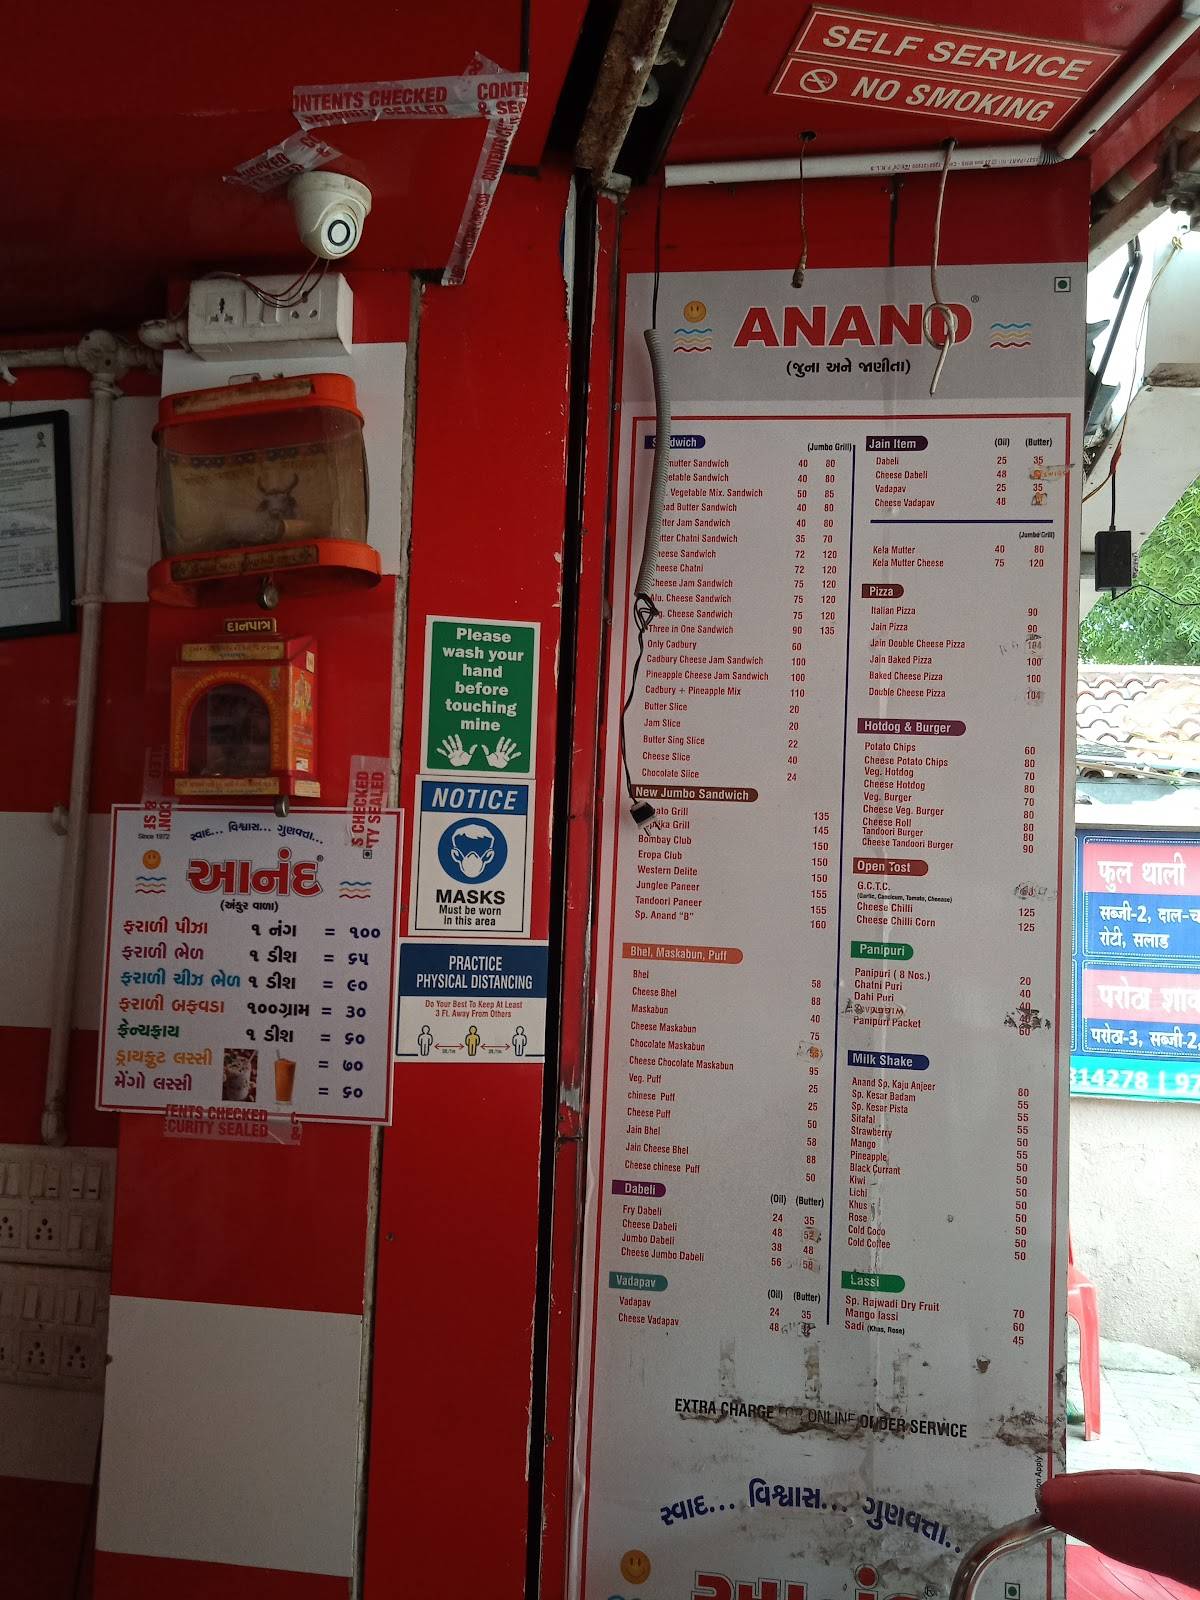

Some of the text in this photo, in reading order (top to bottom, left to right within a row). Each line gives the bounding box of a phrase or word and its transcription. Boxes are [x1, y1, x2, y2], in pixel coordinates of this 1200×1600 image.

[823, 25, 1092, 82] SELF SERVICE
[369, 87, 447, 106] CHECKED
[850, 76, 1055, 121] NO SMOKING
[733, 303, 973, 348] ANAND
[787, 358, 910, 377] (જુના અને જાણીતા)
[808, 443, 852, 452] (Jumbo Grill)
[869, 439, 916, 449] Jain Item
[671, 489, 763, 498] Vegetable Mix. Sandwich
[797, 490, 807, 498] 50
[825, 490, 834, 498] 85
[891, 546, 915, 554] Mutter
[995, 545, 1005, 553] 40
[1034, 545, 1044, 553] 80
[870, 587, 894, 596] Pizza
[871, 607, 915, 615] Italian Pizza
[1028, 608, 1038, 616] 90
[457, 628, 512, 643] Please
[649, 625, 668, 633] Three
[697, 626, 733, 634] Sandwich
[792, 627, 802, 635] 90
[821, 627, 834, 635] 135
[443, 647, 524, 663] wash your
[463, 664, 503, 678] hand
[455, 682, 509, 696] before
[445, 699, 518, 717] touching
[461, 719, 501, 732] mine
[864, 721, 951, 733] Hotdog & Burger
[865, 742, 916, 752] Potato Chips
[1025, 747, 1035, 755] 60
[368, 772, 384, 824] SEALED
[432, 788, 518, 810] NOTICE
[636, 787, 749, 800] New Jumbo Sandwich
[352, 772, 368, 833] CHECKED
[639, 835, 691, 845] Bombay Club
[812, 842, 829, 851] 150
[187, 847, 324, 896] આનંદ
[857, 861, 911, 872] Open Tost
[1098, 861, 1133, 892] फुल
[1142, 853, 1186, 886] थाली
[436, 890, 506, 905] MASKS
[438, 906, 502, 916] Must be worn
[123, 916, 168, 934] ફરાળી
[175, 917, 208, 934] પીઝા
[269, 920, 296, 937] નંગ
[350, 927, 380, 939] ૧૦૦
[444, 916, 496, 926] In this area
[1133, 933, 1170, 949] सलाड
[122, 942, 166, 960] ફરાળી
[175, 943, 204, 959] ભેળ
[267, 946, 296, 963] ડીશ
[631, 947, 727, 960] Bhel, Maskabun, Puff
[860, 944, 905, 956] Panipuri
[449, 956, 502, 971] PRACTICE
[121, 968, 165, 986] ફરાળી
[174, 969, 203, 986] ચીઝ
[211, 970, 240, 987] ભેળ
[266, 972, 296, 989] ડીશ
[416, 974, 533, 990] PHYSICAL DISTANCING
[119, 994, 164, 1011] ફરાળી
[437, 1000, 451, 1008] Your
[453, 1000, 467, 1008] Best
[478, 1001, 494, 1009] Keep
[505, 1001, 523, 1009] Least
[452, 1010, 469, 1018] Away
[264, 1024, 293, 1042] ડીશ
[174, 1048, 212, 1065] લસ્સી
[852, 1053, 913, 1067] Milk Shake
[115, 1071, 145, 1088] મેંગો
[154, 1074, 192, 1091] લસ્સી
[218, 1122, 268, 1137] SEALED
[850, 1139, 876, 1149] Mango
[1016, 1151, 1028, 1160] 55
[625, 1183, 824, 1208] Dabeli (Oil) (Butter)
[616, 1276, 656, 1288] Vadapav
[850, 1275, 879, 1288] Lassi
[846, 1296, 940, 1312] Sp. Rajwadi Dry Fruit
[1013, 1310, 1024, 1318] 70
[675, 1398, 716, 1415] EXTRA
[721, 1401, 774, 1419] CHARGE
[808, 1409, 856, 1425] ONLINE
[911, 1419, 967, 1438] SERVICE
[660, 1495, 735, 1526] સ્વાદ...
